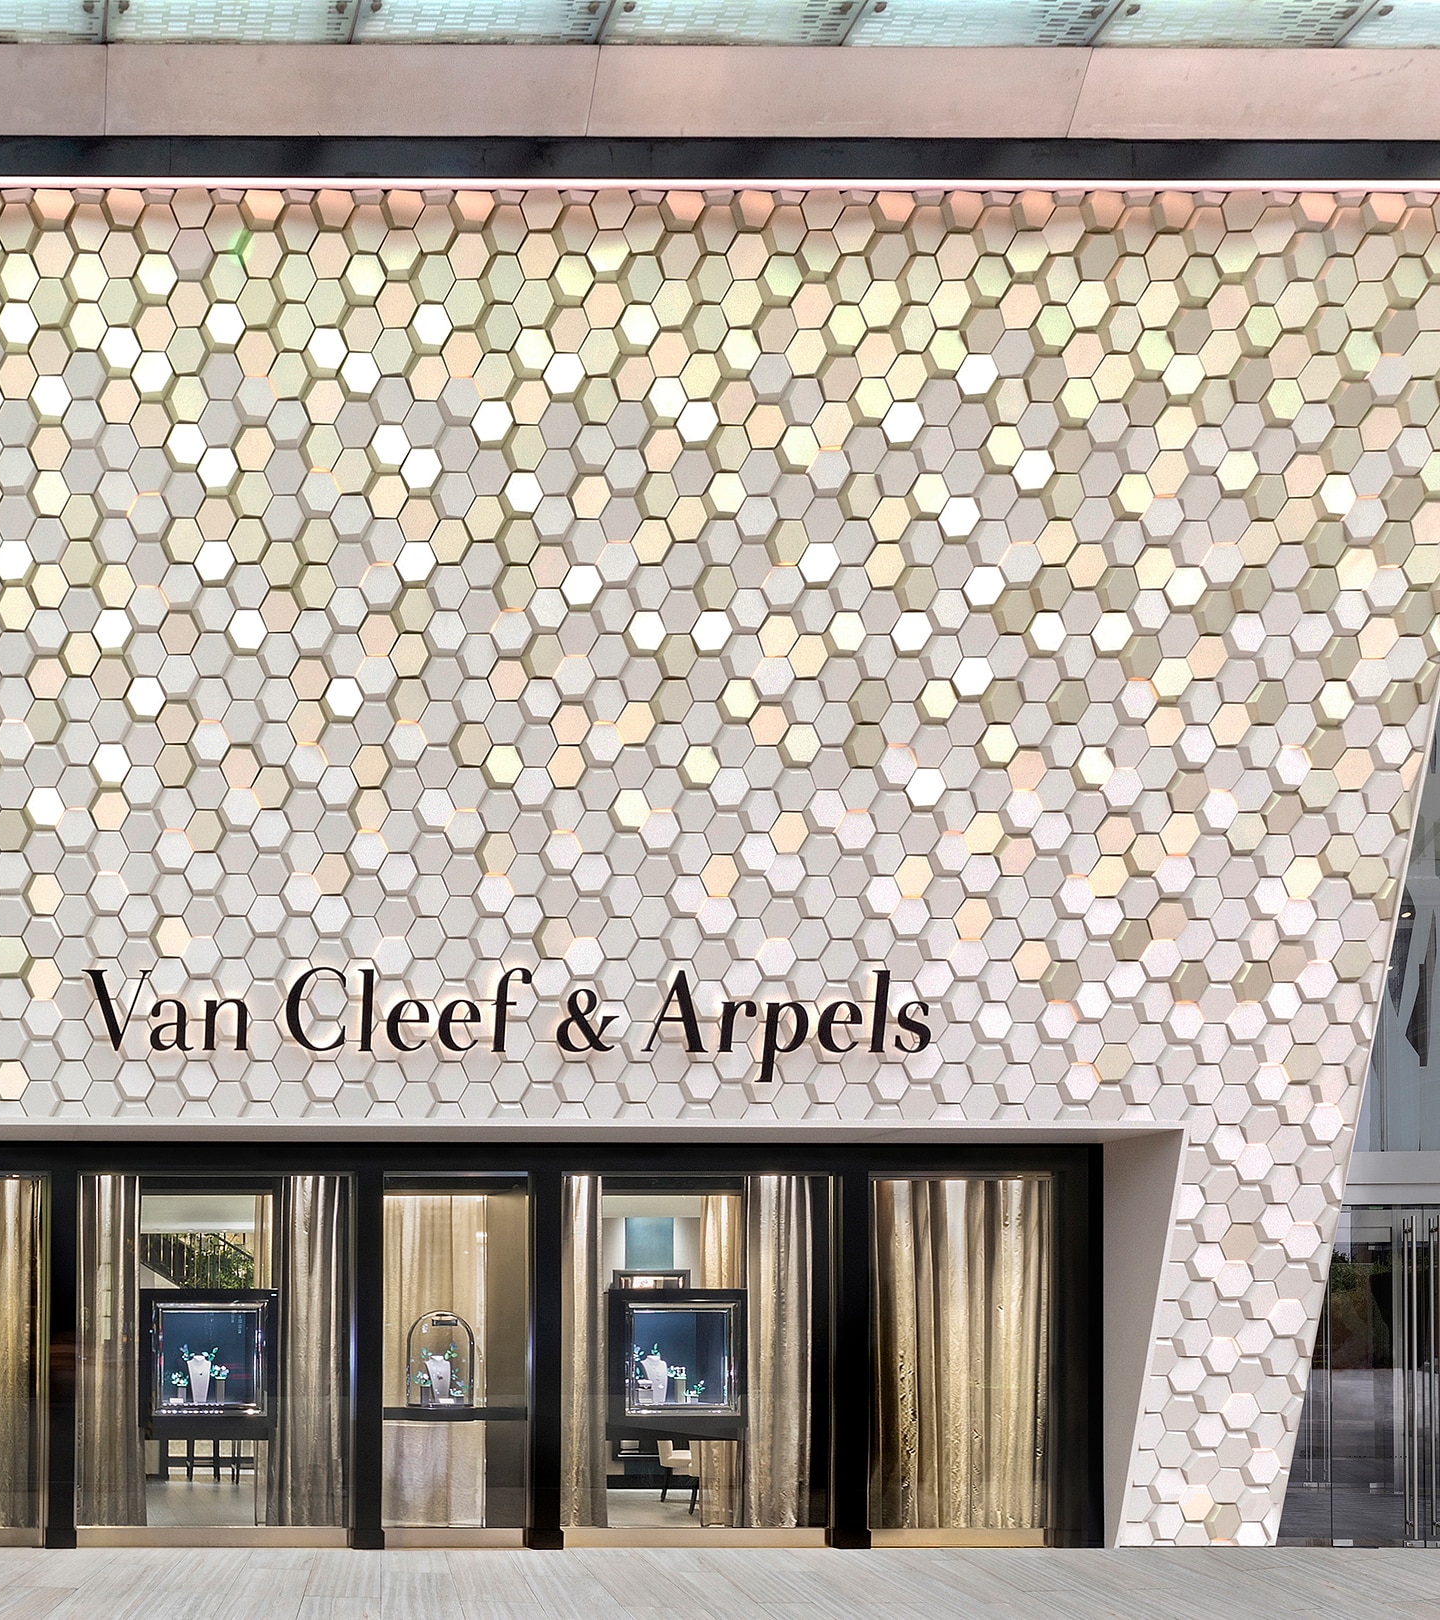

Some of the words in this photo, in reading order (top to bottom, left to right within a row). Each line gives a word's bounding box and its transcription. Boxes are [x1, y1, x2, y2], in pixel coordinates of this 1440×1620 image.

[82, 968, 249, 1052] Van
[285, 966, 533, 1053] Cleef
[557, 988, 620, 1053] &
[640, 969, 932, 1083] Arpels
